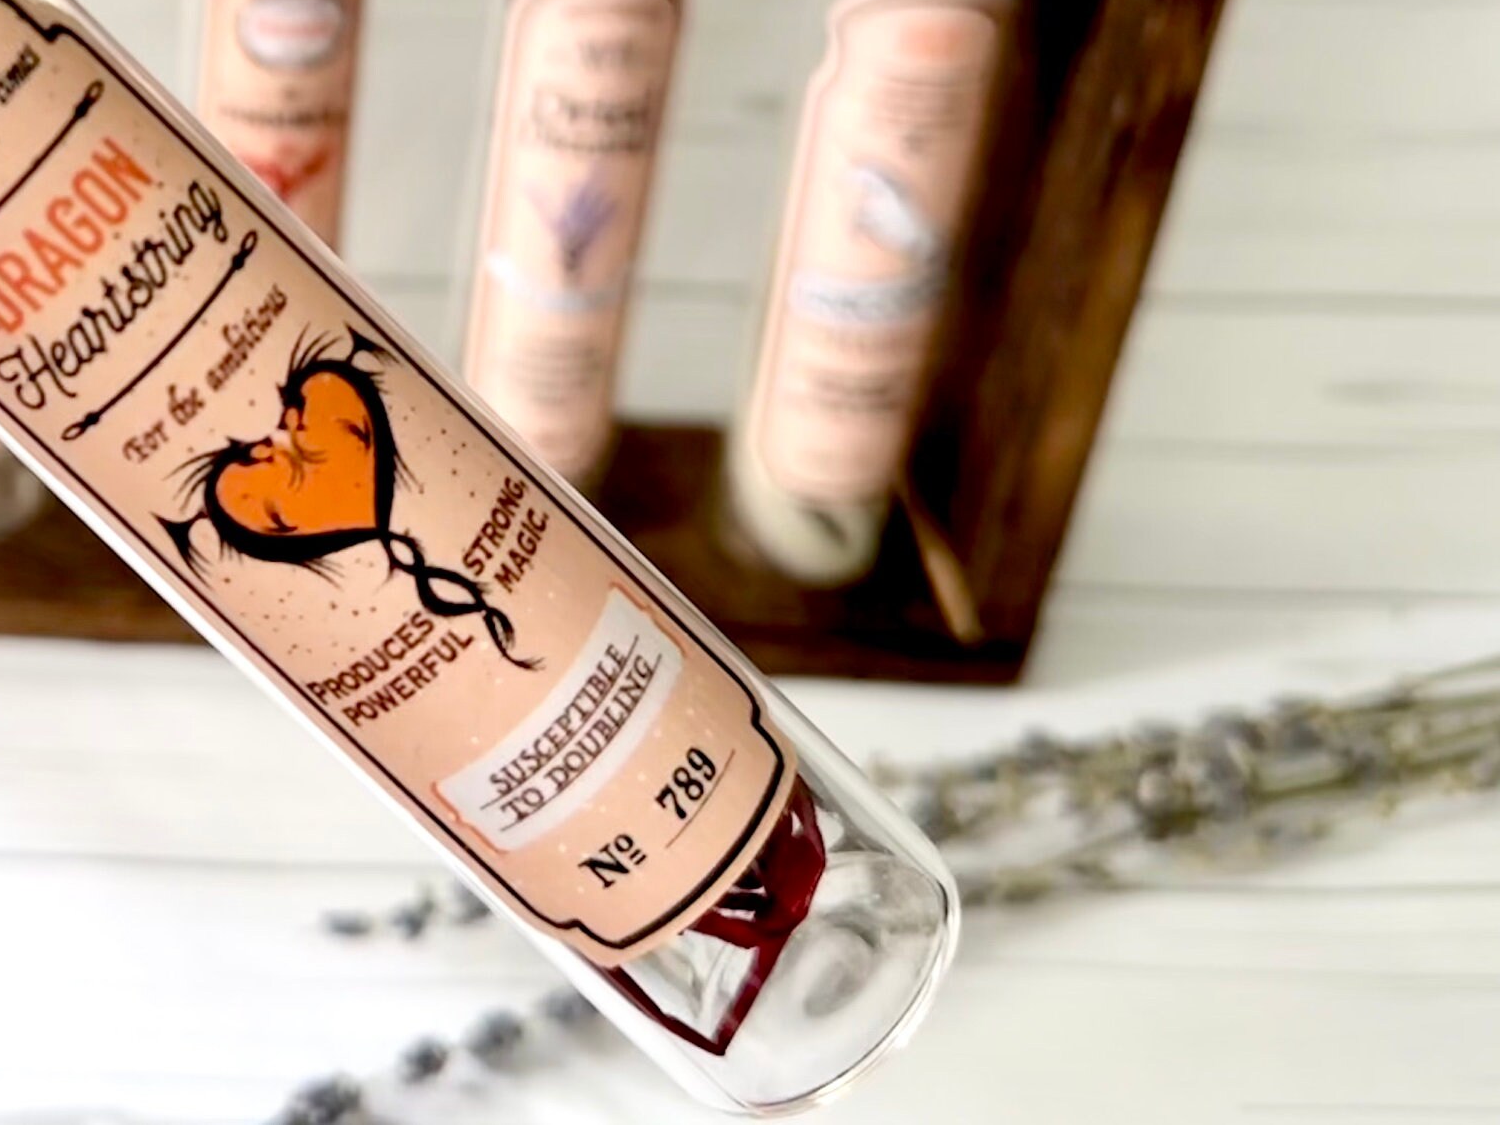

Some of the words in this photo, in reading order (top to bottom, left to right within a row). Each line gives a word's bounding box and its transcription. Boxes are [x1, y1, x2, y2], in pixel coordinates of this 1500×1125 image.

[123, 425, 169, 464] For
[168, 384, 206, 427] the
[206, 282, 288, 393] ambitious
[306, 611, 434, 706] PRODUCES
[342, 630, 475, 727] POWERFUL
[493, 510, 550, 595] MAGIC.
[490, 643, 627, 796] SUSCEPTIBLE
[499, 787, 545, 826] TO
[554, 653, 654, 792] DOUBLING
[655, 746, 717, 821] 789
